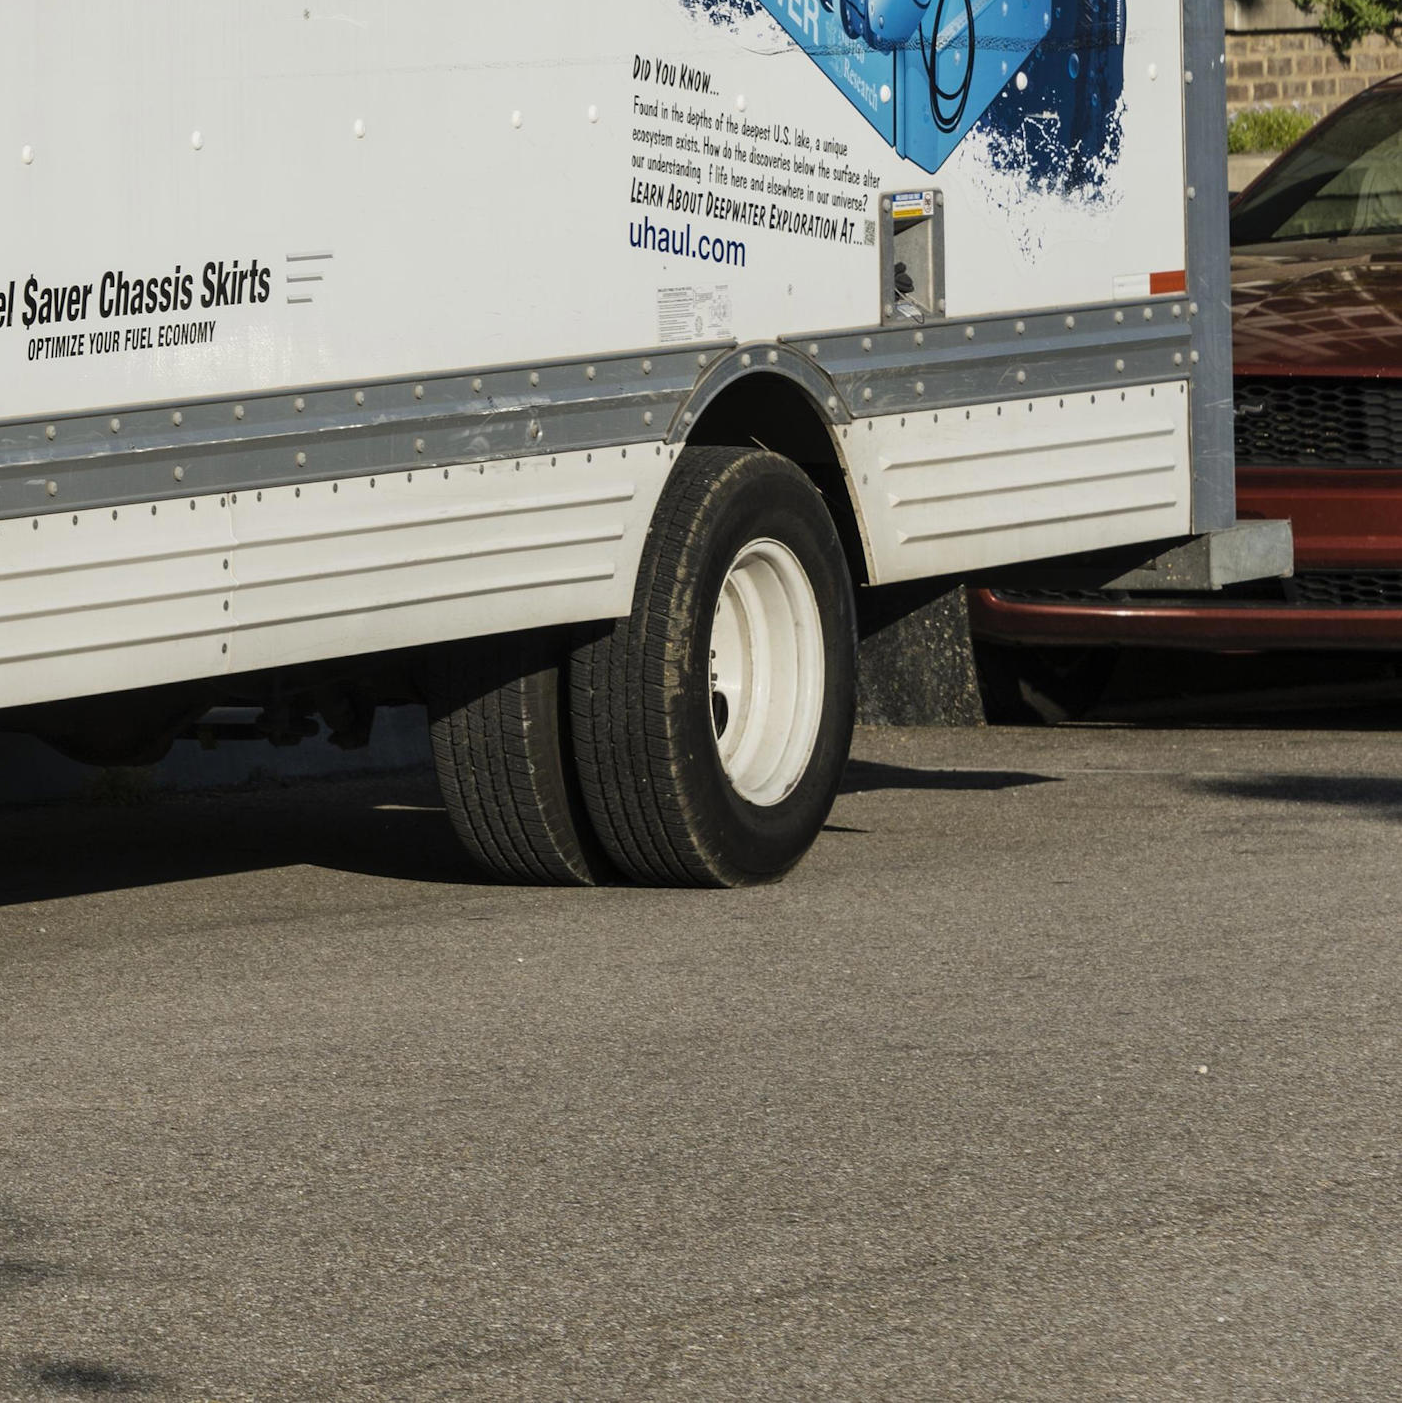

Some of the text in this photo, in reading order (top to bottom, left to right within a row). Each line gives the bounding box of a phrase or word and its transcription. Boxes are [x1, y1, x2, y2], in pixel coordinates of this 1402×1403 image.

[844, 57, 878, 112] Research
[633, 95, 848, 159] Found in the depths of the deepest U.S. lake, a unique
[631, 154, 645, 169] our
[647, 153, 701, 185] understanding
[715, 164, 728, 186] life
[731, 168, 747, 190] here
[750, 175, 764, 192] and
[767, 176, 804, 201] elsewhere
[807, 185, 814, 198] in
[817, 190, 829, 204] our
[832, 191, 868, 213] universe?
[632, 127, 880, 189] ecosystem exists. How do the discoveries below the surface alter
[629, 216, 746, 267] uhaul.com
[22, 274, 94, 330] $aver
[99, 265, 194, 318] Chassis
[201, 259, 272, 309] Skirts
[27, 321, 216, 362] OPTIMIZE YOUR FUEL ECONOMY
